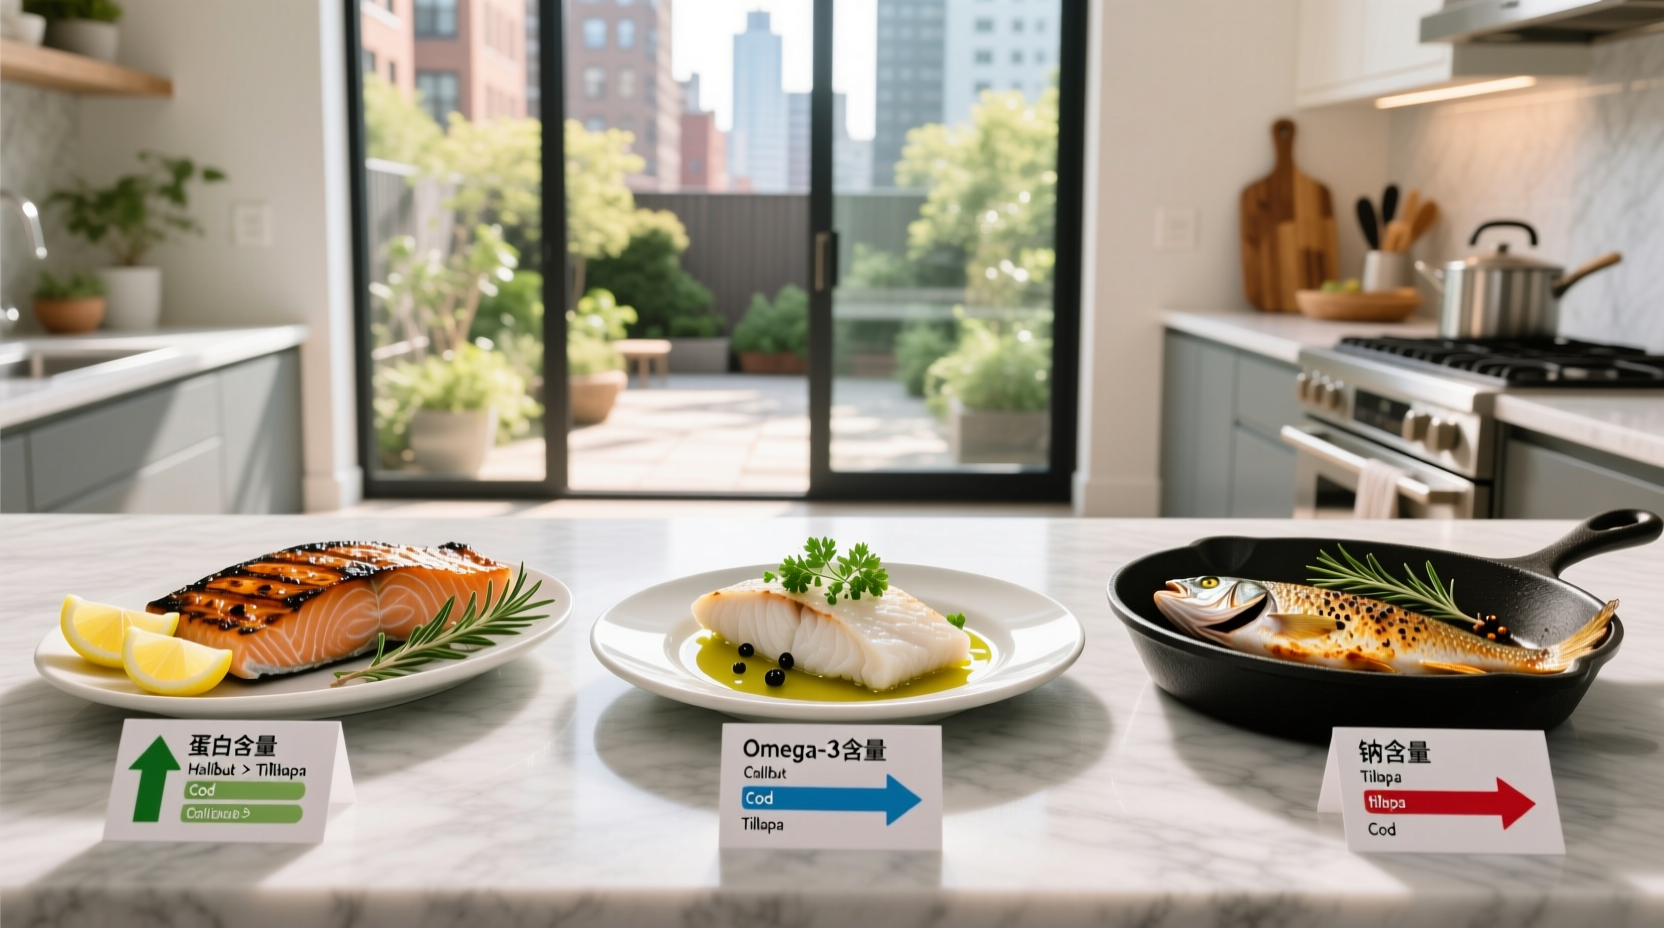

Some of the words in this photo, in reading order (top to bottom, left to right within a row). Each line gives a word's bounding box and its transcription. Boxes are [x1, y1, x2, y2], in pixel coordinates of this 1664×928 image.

[743, 737, 886, 763] Omega-3含量
[189, 782, 216, 796] Cod
[746, 790, 773, 804] Cod
[1368, 821, 1396, 836] Cod
